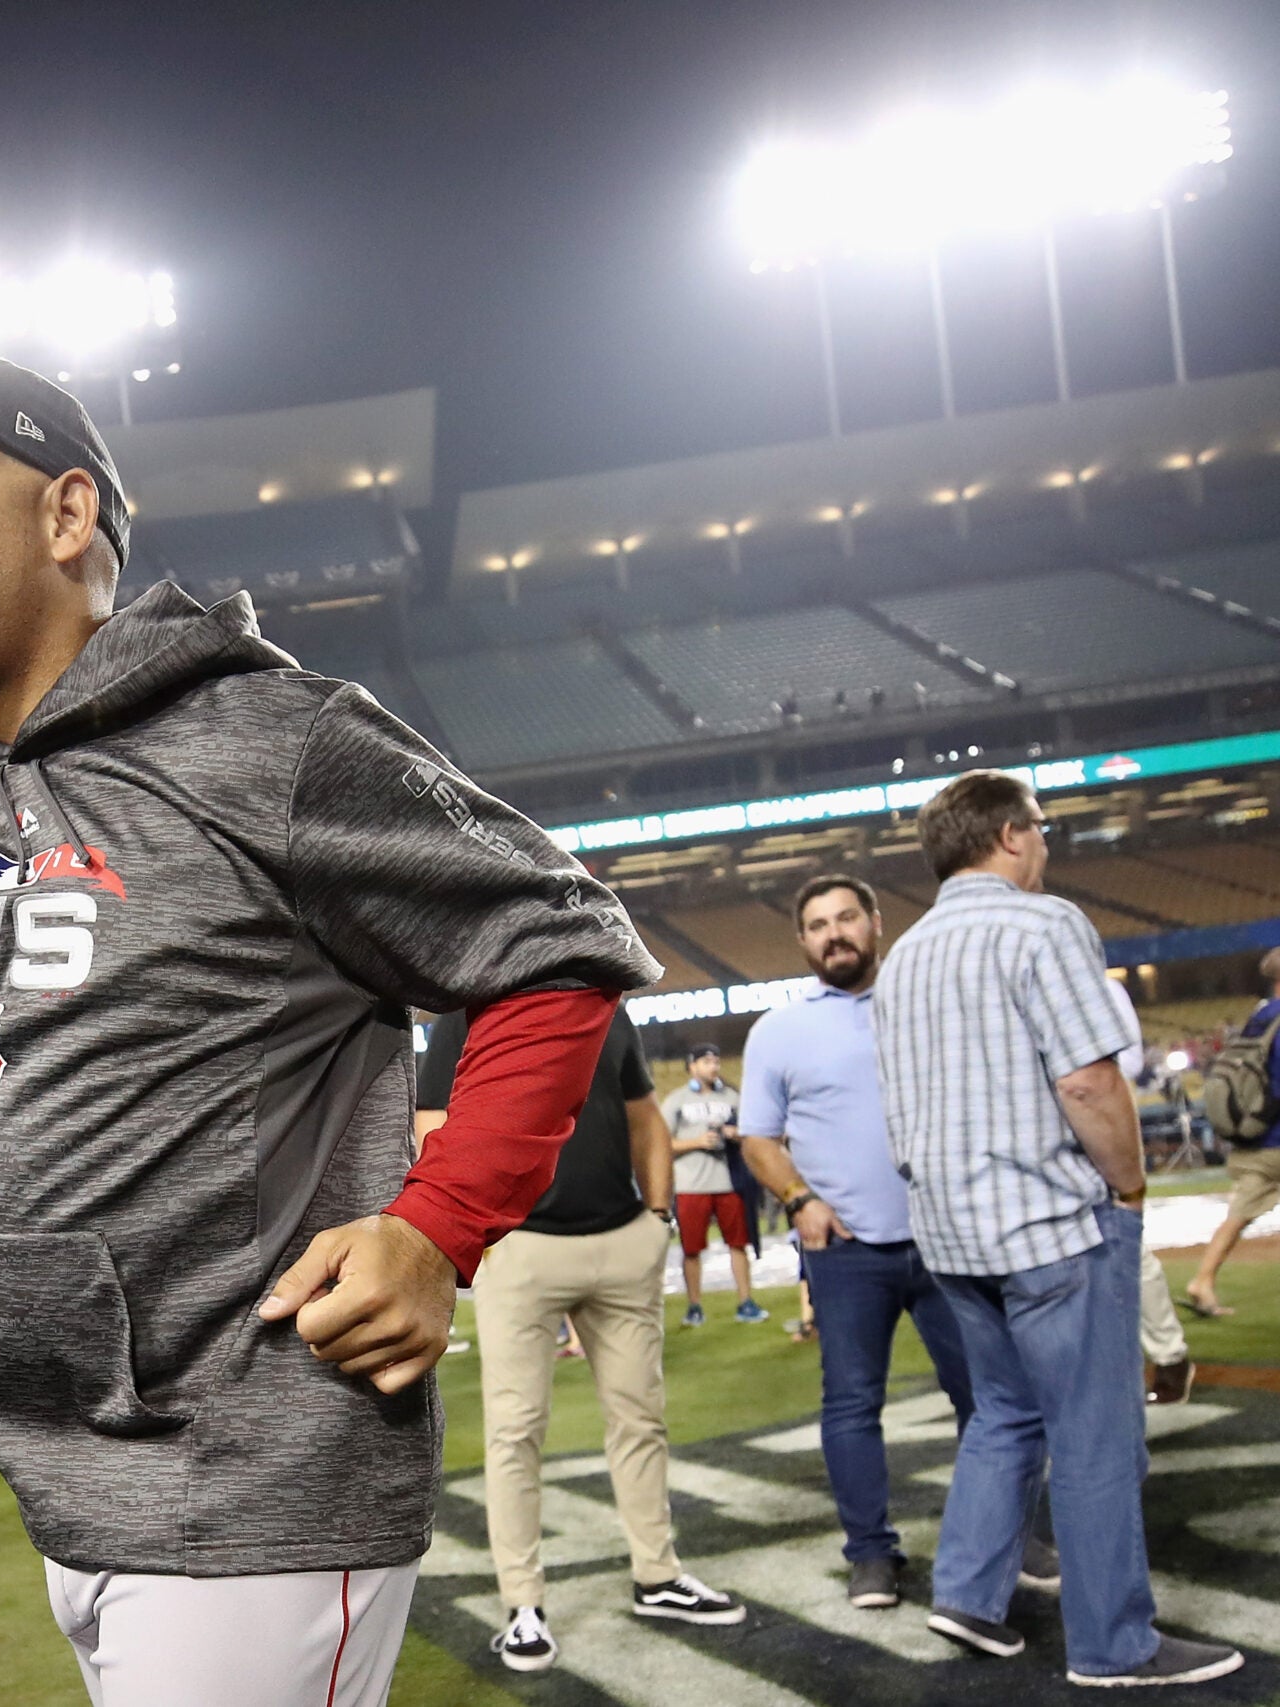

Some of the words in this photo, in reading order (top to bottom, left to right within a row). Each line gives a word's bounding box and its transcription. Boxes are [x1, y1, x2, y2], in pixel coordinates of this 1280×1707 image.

[431, 780, 536, 871] SERIES
[547, 870, 633, 952] WORL
[625, 987, 726, 1027] PIONS
